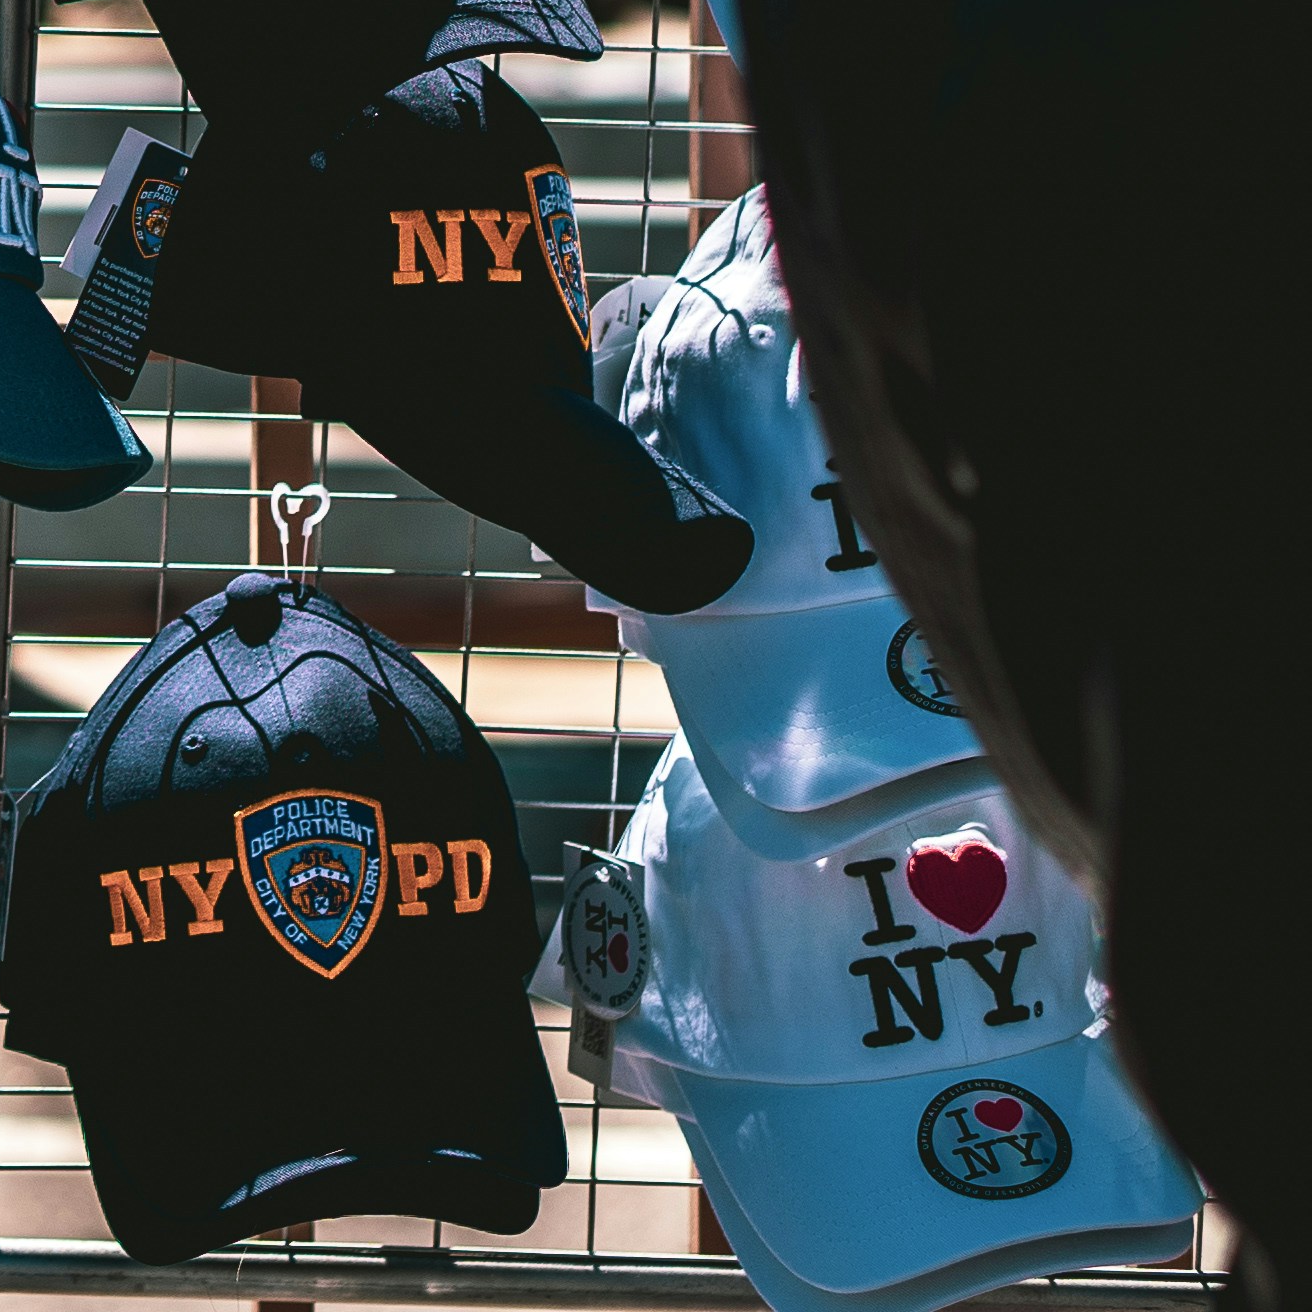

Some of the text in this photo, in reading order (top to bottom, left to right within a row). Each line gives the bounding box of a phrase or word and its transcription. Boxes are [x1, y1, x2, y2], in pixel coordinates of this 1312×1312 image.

[157, 183, 180, 198] POLI
[390, 209, 531, 284] NY
[250, 817, 375, 858] DEPARTMENT
[273, 799, 350, 825] POLICE
[100, 838, 491, 947] NY PD
[255, 878, 308, 945] CITY OF
[336, 856, 380, 951] NEW YORK
[844, 858, 916, 946] I
[944, 1107, 980, 1144] I
